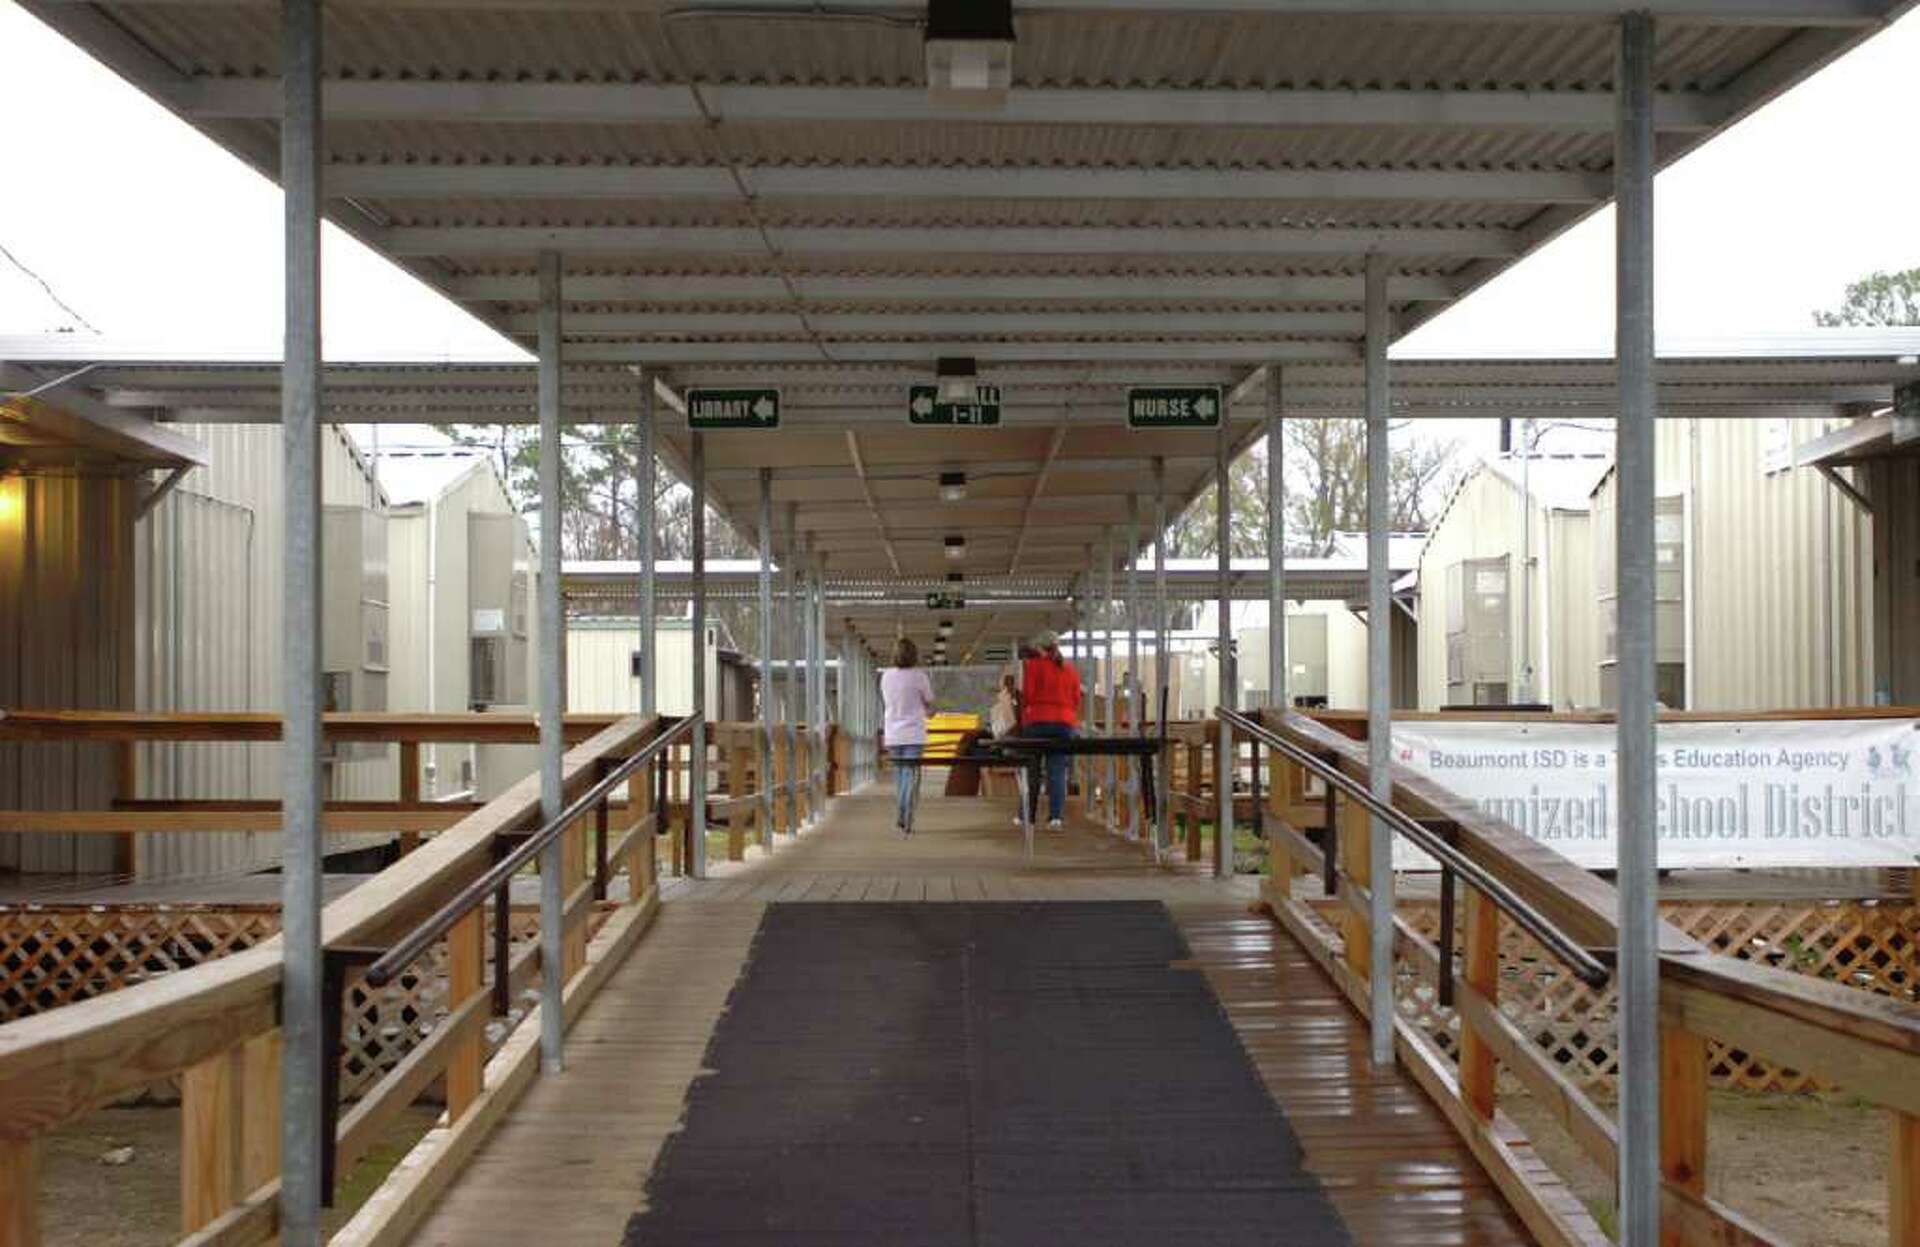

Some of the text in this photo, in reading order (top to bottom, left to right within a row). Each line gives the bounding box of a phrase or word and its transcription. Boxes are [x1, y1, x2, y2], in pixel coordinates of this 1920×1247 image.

[692, 400, 751, 419] LIBRARY
[1134, 398, 1191, 418] NURSE
[1429, 750, 1528, 769] Beaumont
[1533, 749, 1567, 768] ISD
[1573, 749, 1590, 768] is
[1595, 752, 1606, 768] a
[1673, 748, 1773, 769] Education
[1776, 748, 1849, 772] Agency
[1656, 783, 1750, 840] chool
[1764, 782, 1910, 839] District
